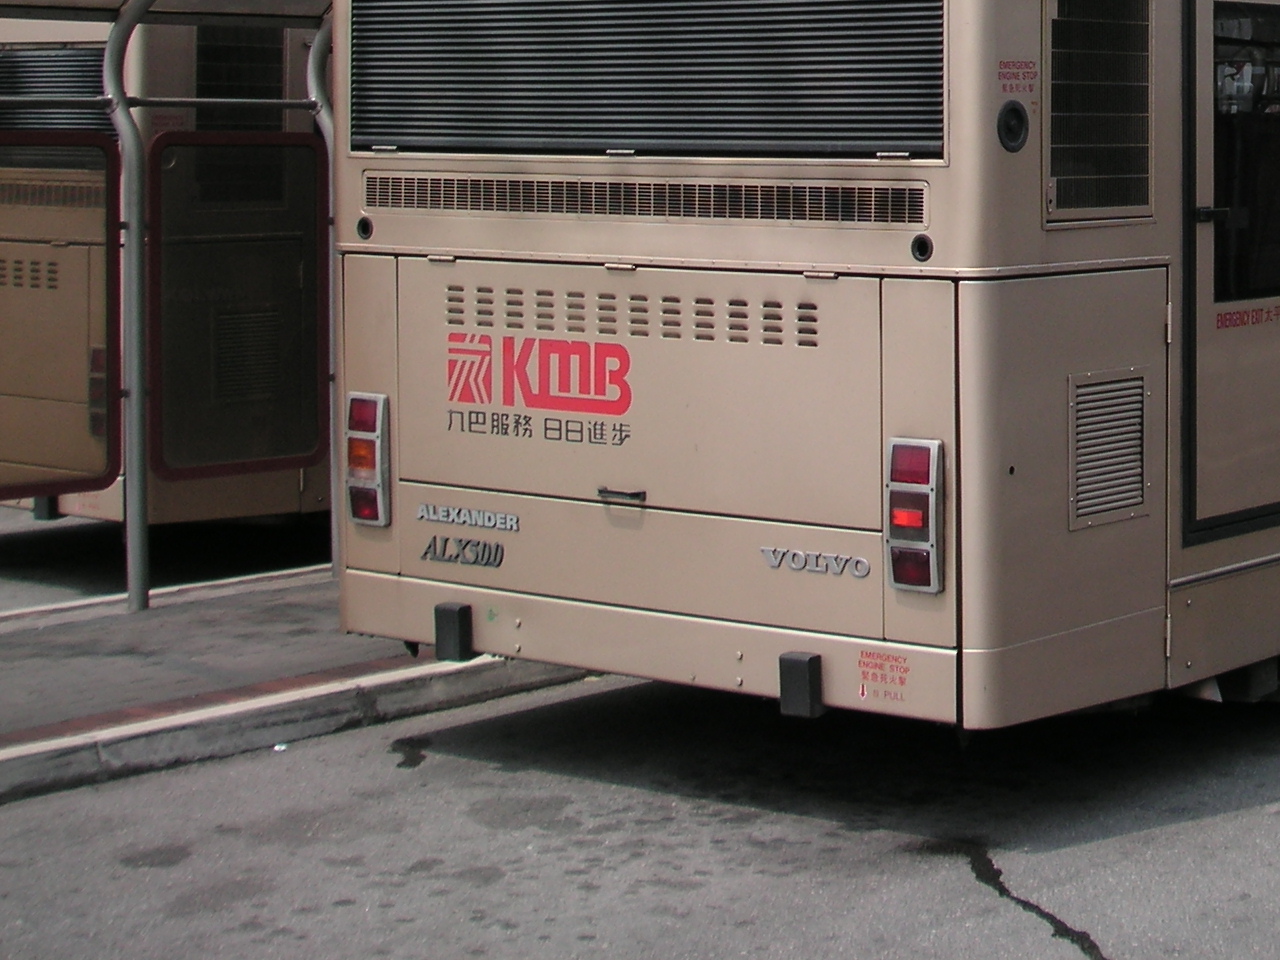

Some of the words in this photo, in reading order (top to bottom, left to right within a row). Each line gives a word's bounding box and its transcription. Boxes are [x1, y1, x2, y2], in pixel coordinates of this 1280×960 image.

[998, 71, 1020, 80] ENGINE
[1022, 71, 1038, 80] STOP
[999, 61, 1036, 70] EMERGENCY
[1216, 310, 1250, 329] EMERGENCY
[1251, 308, 1264, 325] EXIT
[503, 336, 632, 416] KMB
[447, 409, 533, 439] 九巴服務
[544, 417, 632, 446] 日日進步
[417, 503, 520, 532] ALEXANDER
[421, 534, 505, 568] ALX500
[760, 547, 871, 578] VOLVO
[858, 660, 885, 671] ENGINE
[889, 664, 911, 675] STOP
[860, 650, 908, 664] EMERGENCY
[884, 690, 906, 702] PULL
